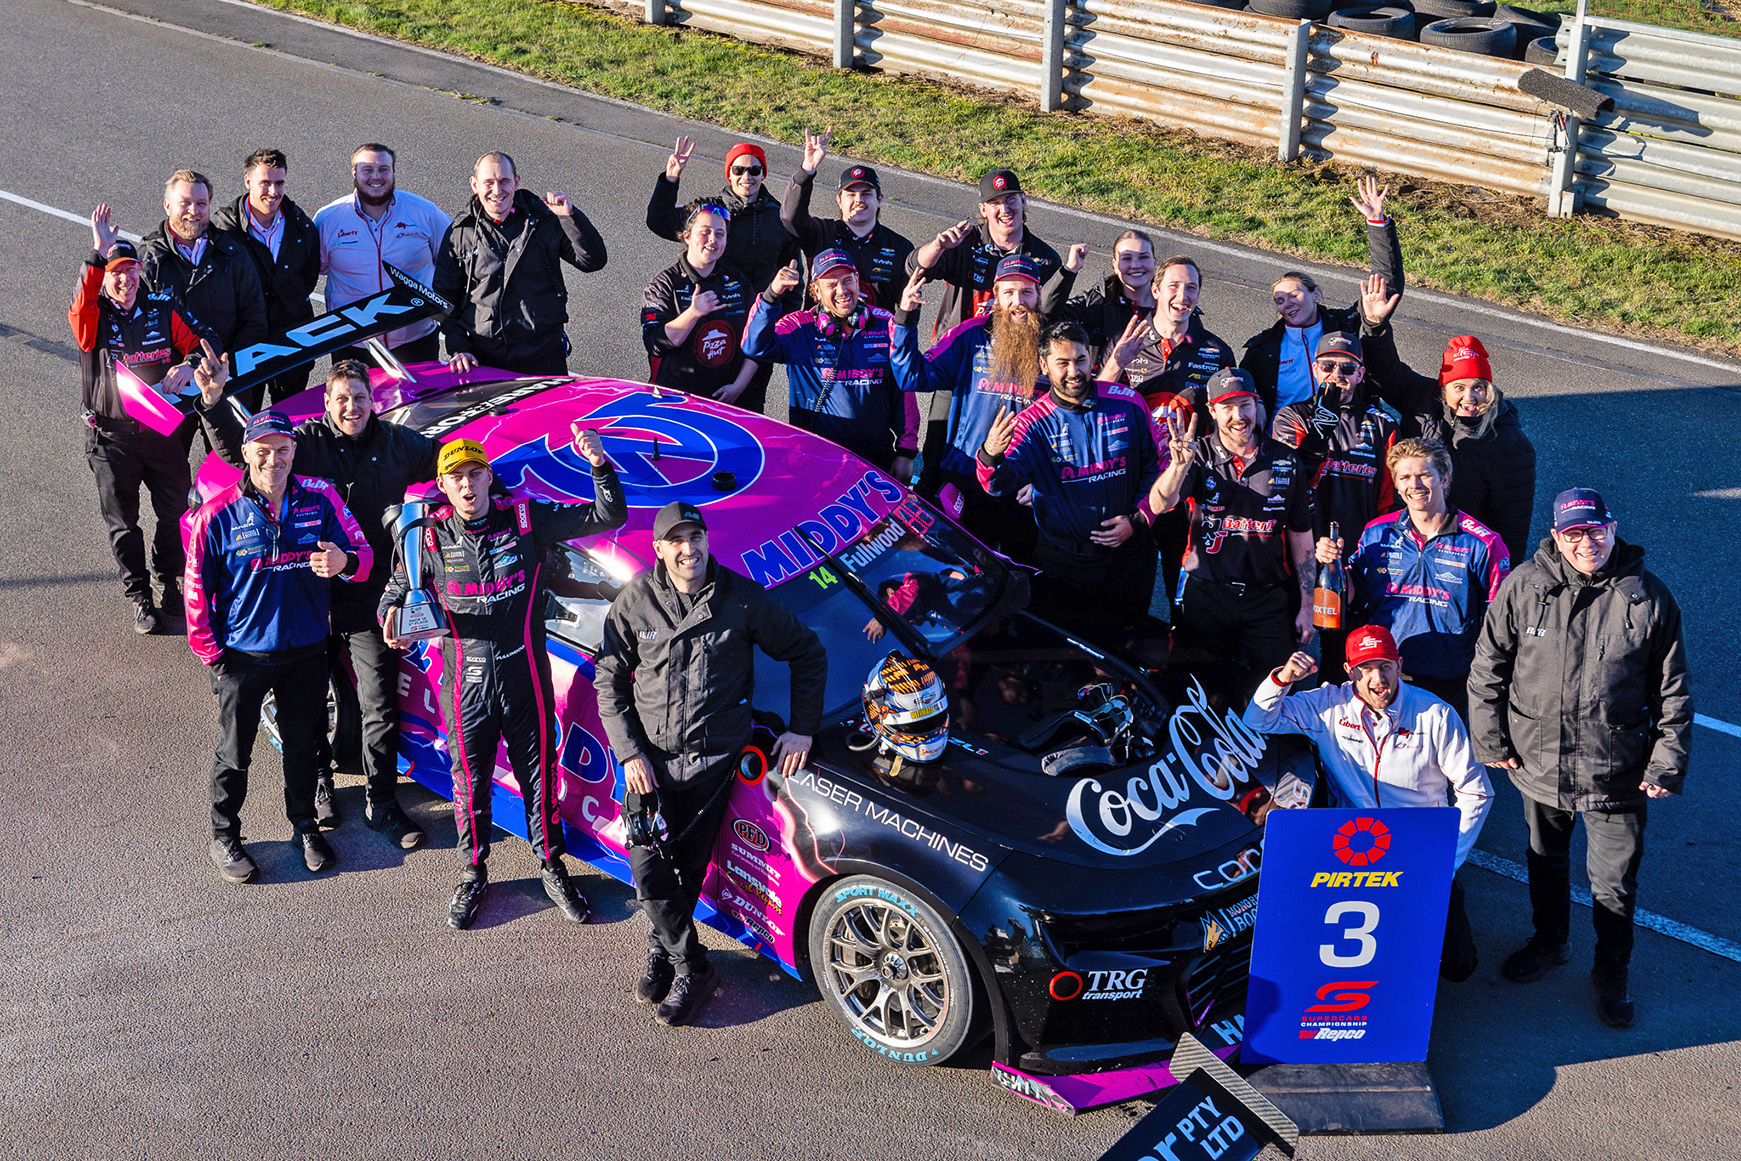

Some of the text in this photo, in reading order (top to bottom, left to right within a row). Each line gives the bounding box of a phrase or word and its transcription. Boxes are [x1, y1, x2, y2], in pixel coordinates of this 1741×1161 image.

[390, 266, 448, 309] Wagga Motors
[702, 339, 727, 353] Pizza
[707, 347, 726, 360] Hut
[837, 368, 884, 380] MIDDY'S
[1188, 361, 1220, 372] Fastron
[1107, 385, 1136, 397] BJR
[444, 445, 483, 461] DUNLOP
[1078, 456, 1127, 478] MIDDY'S
[1088, 468, 1127, 483] RACING
[1323, 458, 1377, 475] Batteries
[302, 478, 329, 490] BJR
[741, 470, 902, 588] MIDDY'S
[1462, 518, 1491, 537] BJR
[809, 518, 906, 590] 14 Fullwood
[464, 570, 526, 595] MIDDY'S
[1400, 585, 1450, 601] MIDDY'S
[477, 583, 525, 604] RACING
[1409, 596, 1448, 608] RACING
[1313, 604, 1338, 615] OXTEL
[789, 769, 990, 872] LASER MACHINES
[738, 822, 767, 847] PFD
[731, 843, 781, 880] SUMMIT
[727, 859, 782, 909] Lansvale
[1311, 872, 1403, 887] PIRTEK
[834, 885, 920, 918] SPORT MAXX
[733, 895, 785, 936] DUNLOP
[744, 915, 775, 944] Repco
[1319, 901, 1380, 968] 3
[1088, 969, 1148, 991] TRG
[1082, 989, 1143, 1001] transport
[851, 1028, 928, 1062] DUNLOP
[1314, 1028, 1366, 1041] Repco
[1176, 1095, 1221, 1142] PTY
[1200, 1115, 1245, 1160] LTD
